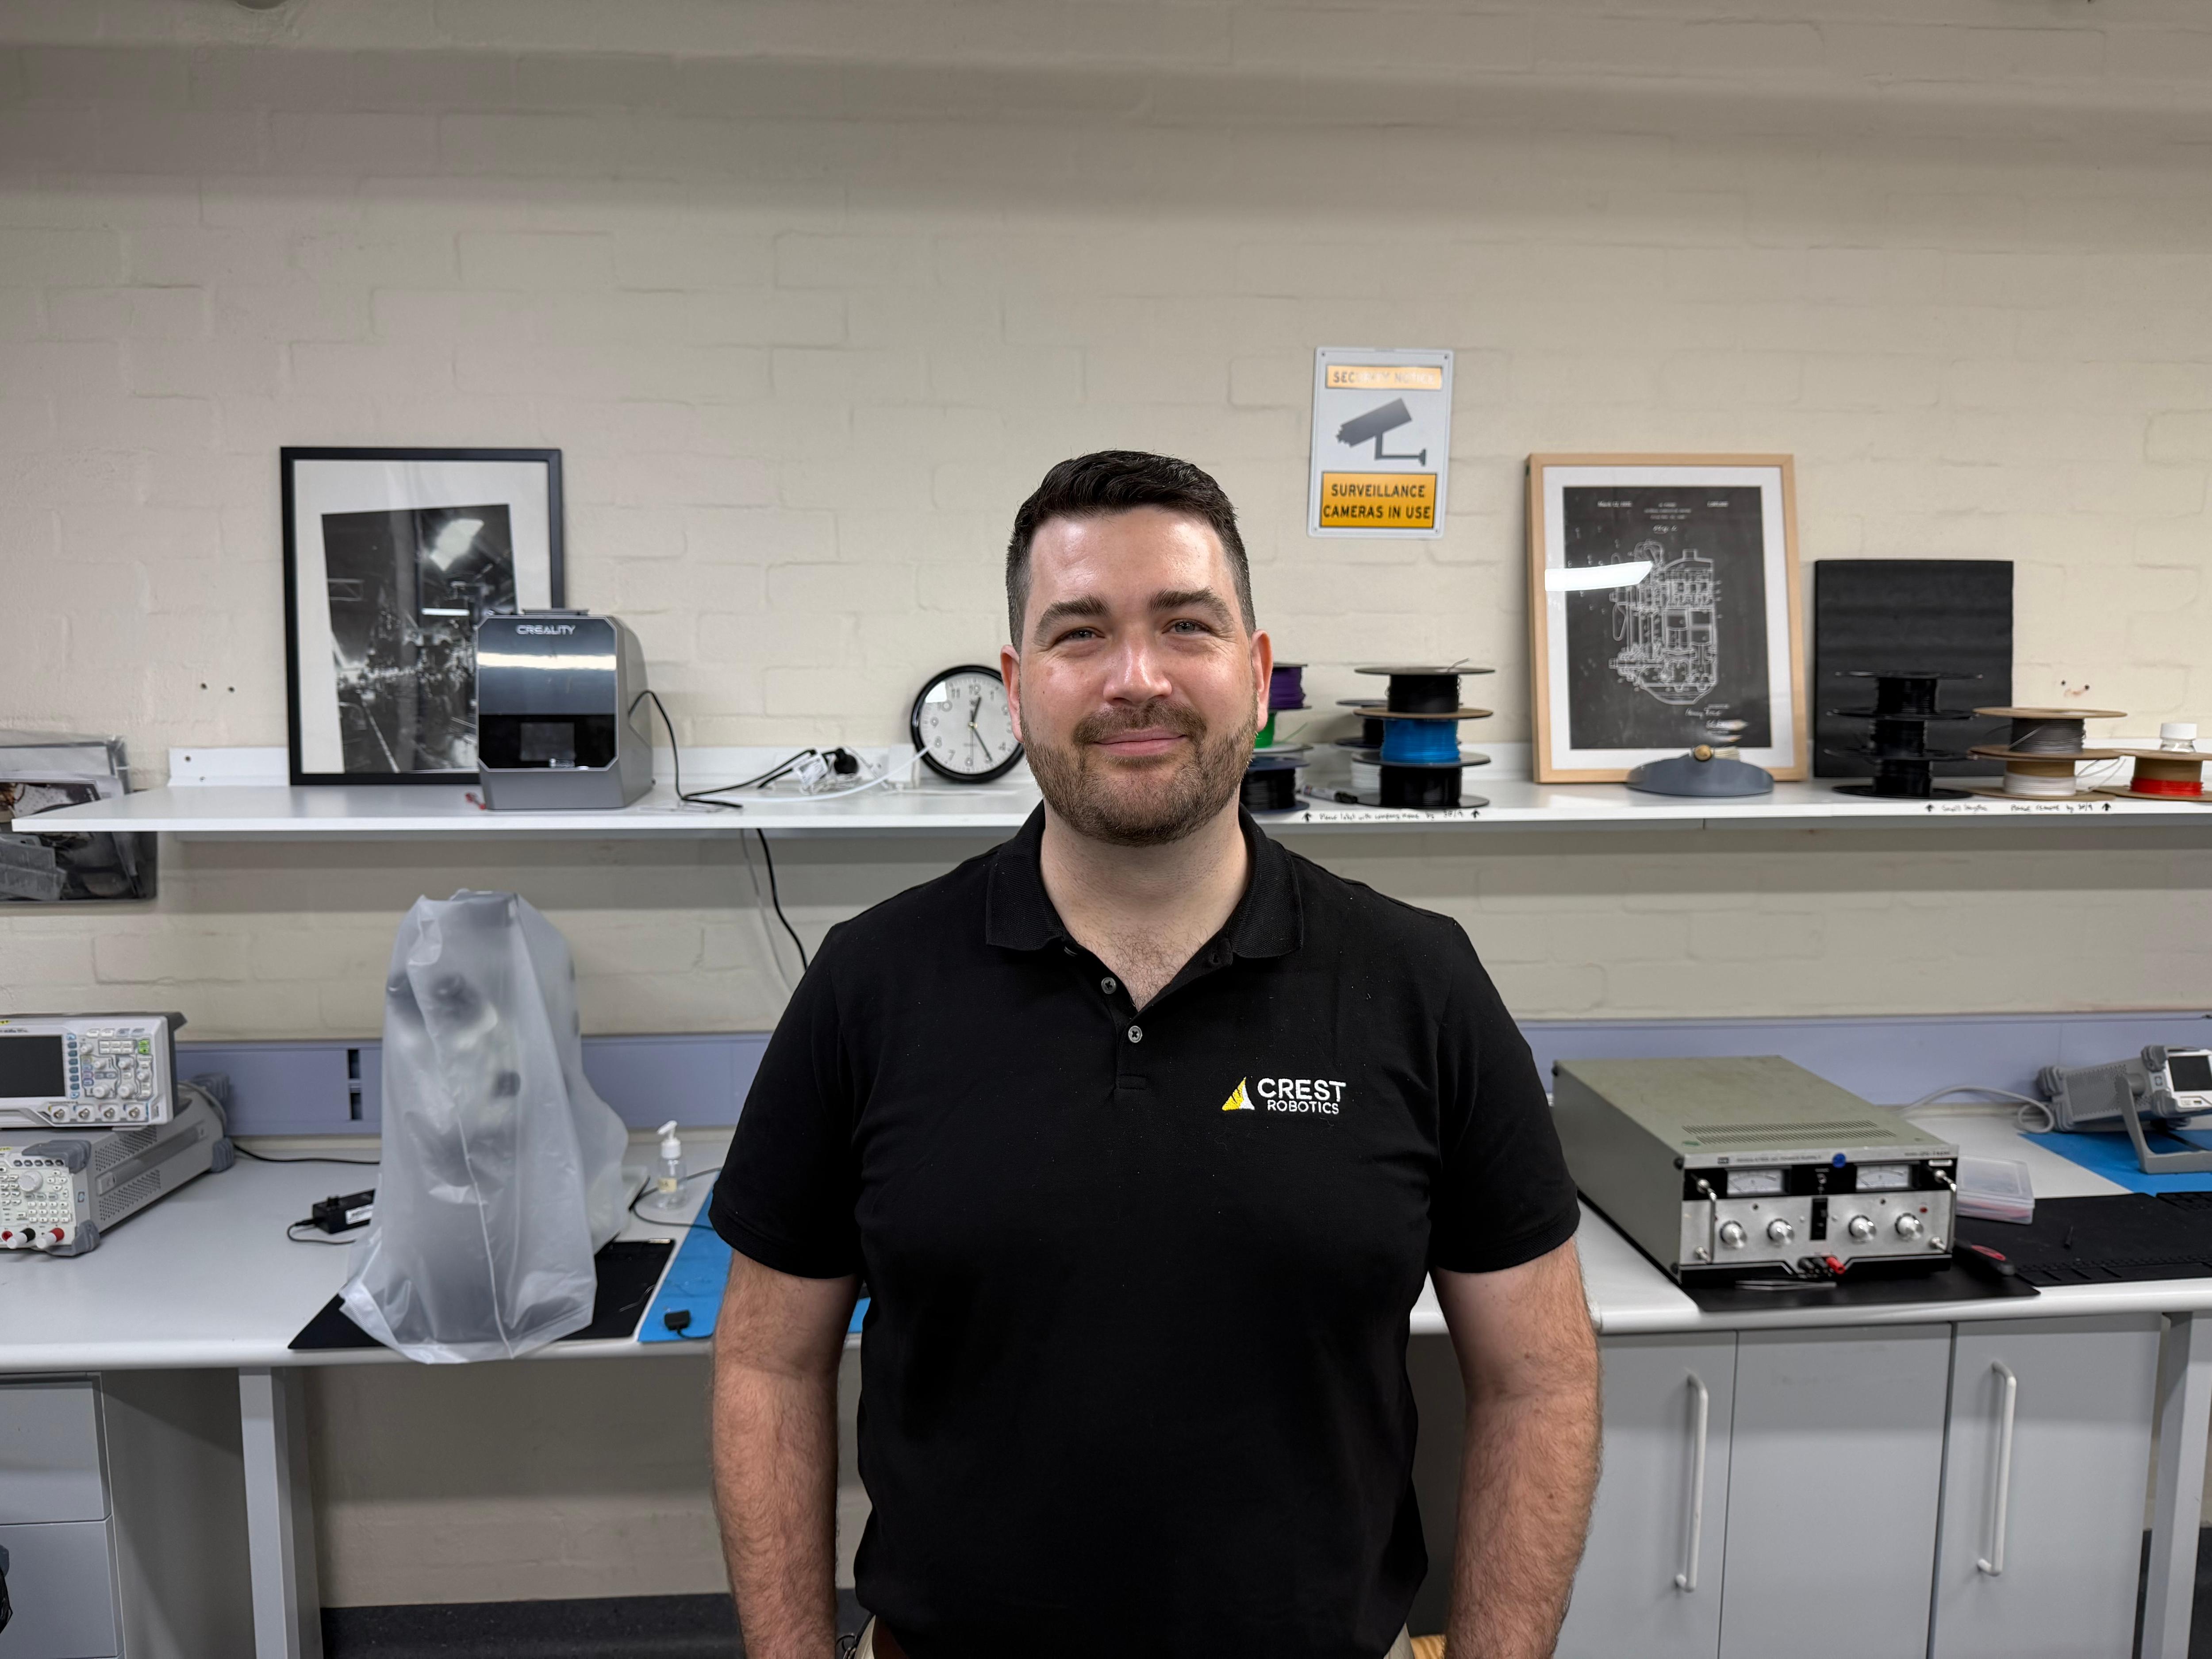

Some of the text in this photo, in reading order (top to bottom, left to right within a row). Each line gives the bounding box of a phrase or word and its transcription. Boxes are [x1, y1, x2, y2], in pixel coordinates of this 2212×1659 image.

[1333, 371, 1390, 384] SECRTY
[1331, 483, 1426, 498] SURVEILLANCE
[1323, 504, 1431, 519] CAMERAS IN USE
[516, 624, 576, 635] CREALITY
[951, 688, 960, 699] 11
[937, 700, 953, 712] 10
[930, 716, 939, 728] 9
[998, 741, 1006, 751] 4
[948, 749, 956, 761] 7
[2066, 803, 2074, 814] by
[1257, 1078, 1346, 1102] CREST
[1267, 1099, 1339, 1114] ROBOTICS
